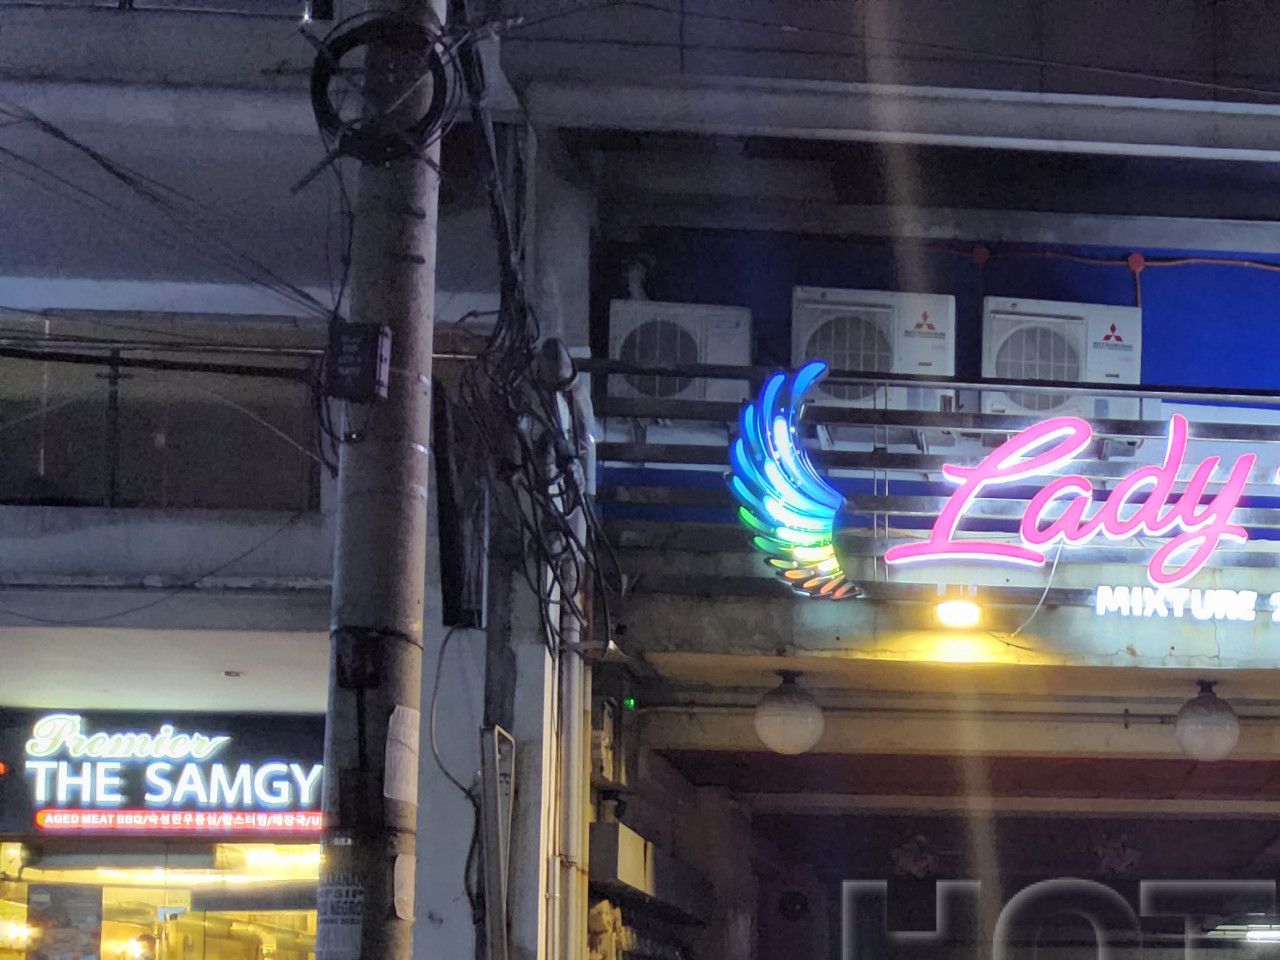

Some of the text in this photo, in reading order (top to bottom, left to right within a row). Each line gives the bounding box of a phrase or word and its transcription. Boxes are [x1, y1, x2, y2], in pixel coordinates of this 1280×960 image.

[885, 413, 1247, 585] Lady
[1096, 586, 1258, 620] MIXTURE
[25, 714, 231, 758] Premier
[25, 761, 323, 804] THE SAMGY
[44, 814, 79, 825] AGED
[81, 814, 114, 825] MEAT
